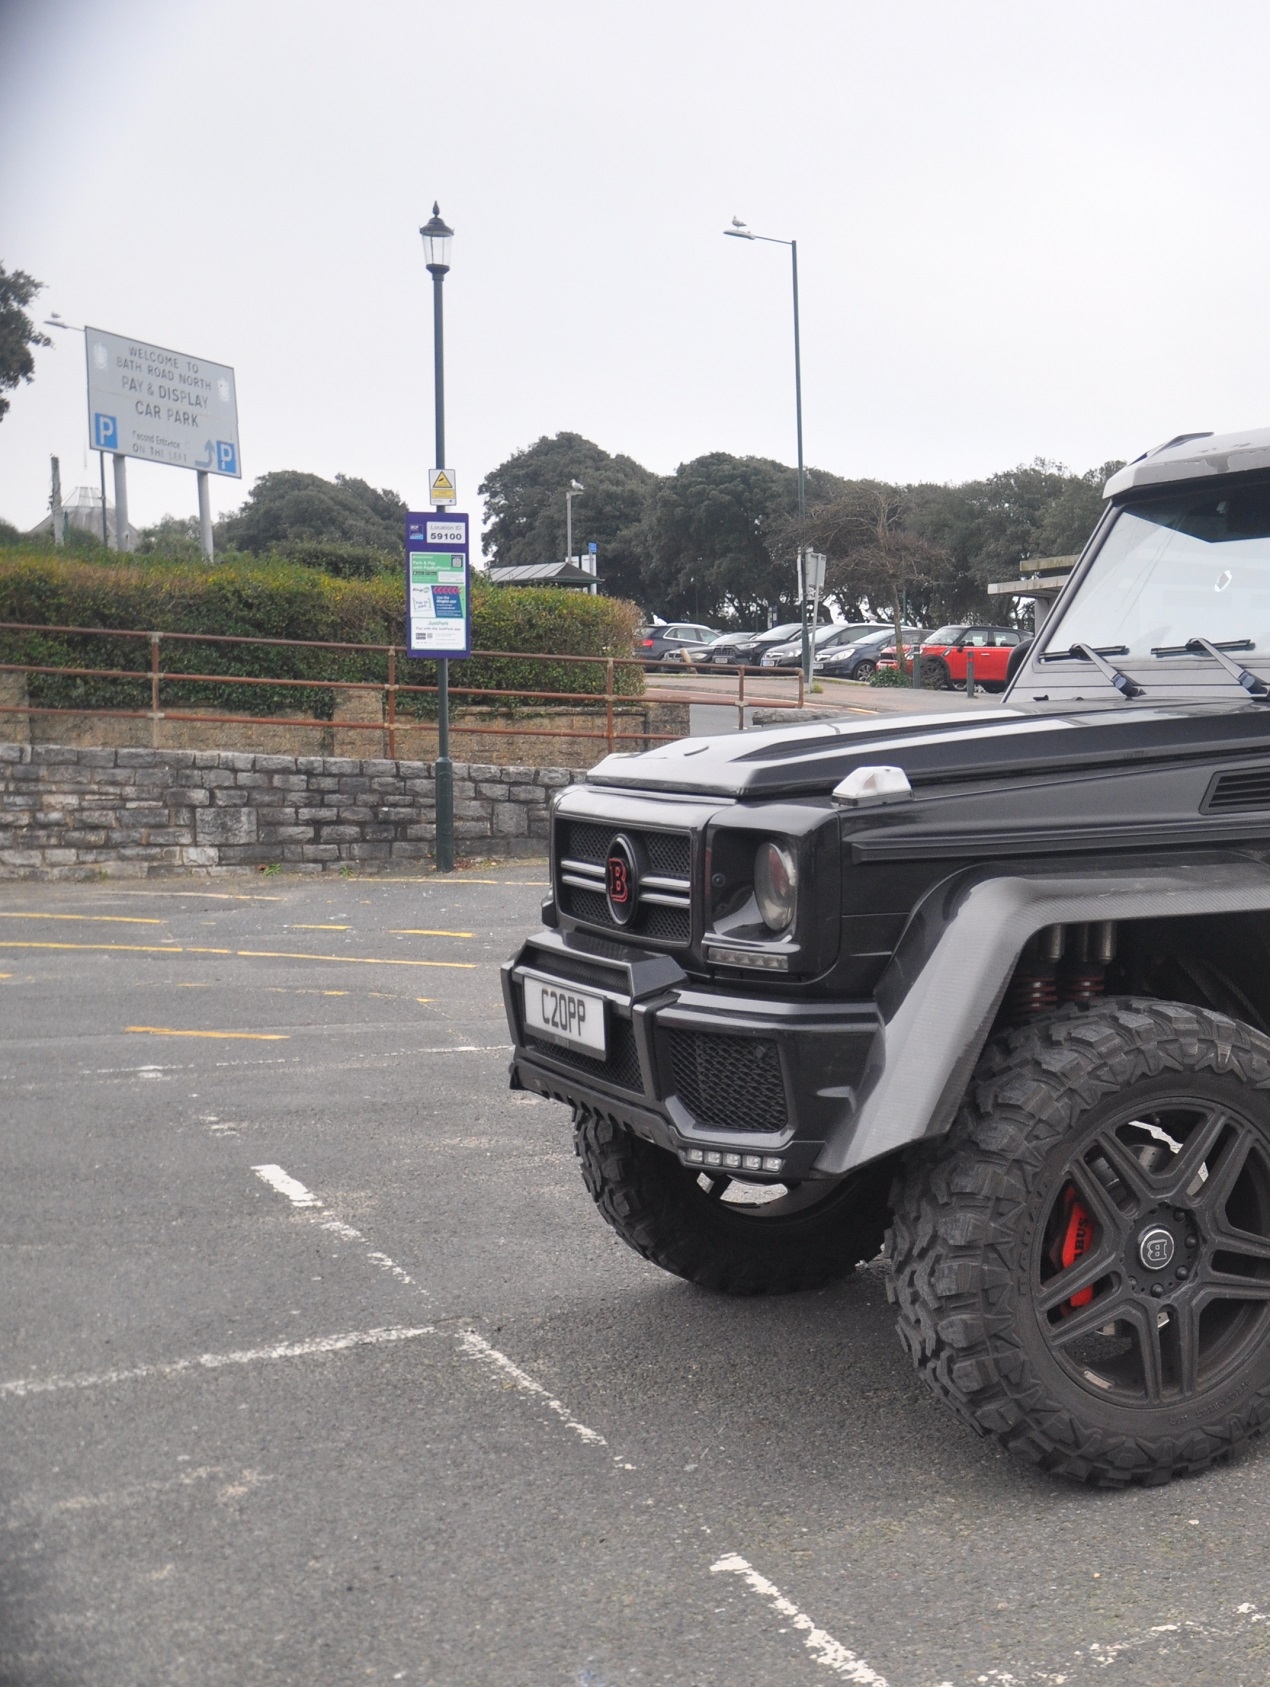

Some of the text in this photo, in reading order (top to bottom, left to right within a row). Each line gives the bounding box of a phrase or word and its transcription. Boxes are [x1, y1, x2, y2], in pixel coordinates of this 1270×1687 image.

[116, 356, 211, 390] BATH ROAD NORTH
[129, 346, 199, 374] WELCOME TO
[122, 376, 208, 409] PAY & DISPLAY
[135, 400, 199, 428] CAR PARK
[99, 417, 113, 444] P
[149, 446, 164, 458] THE
[221, 445, 233, 470] P
